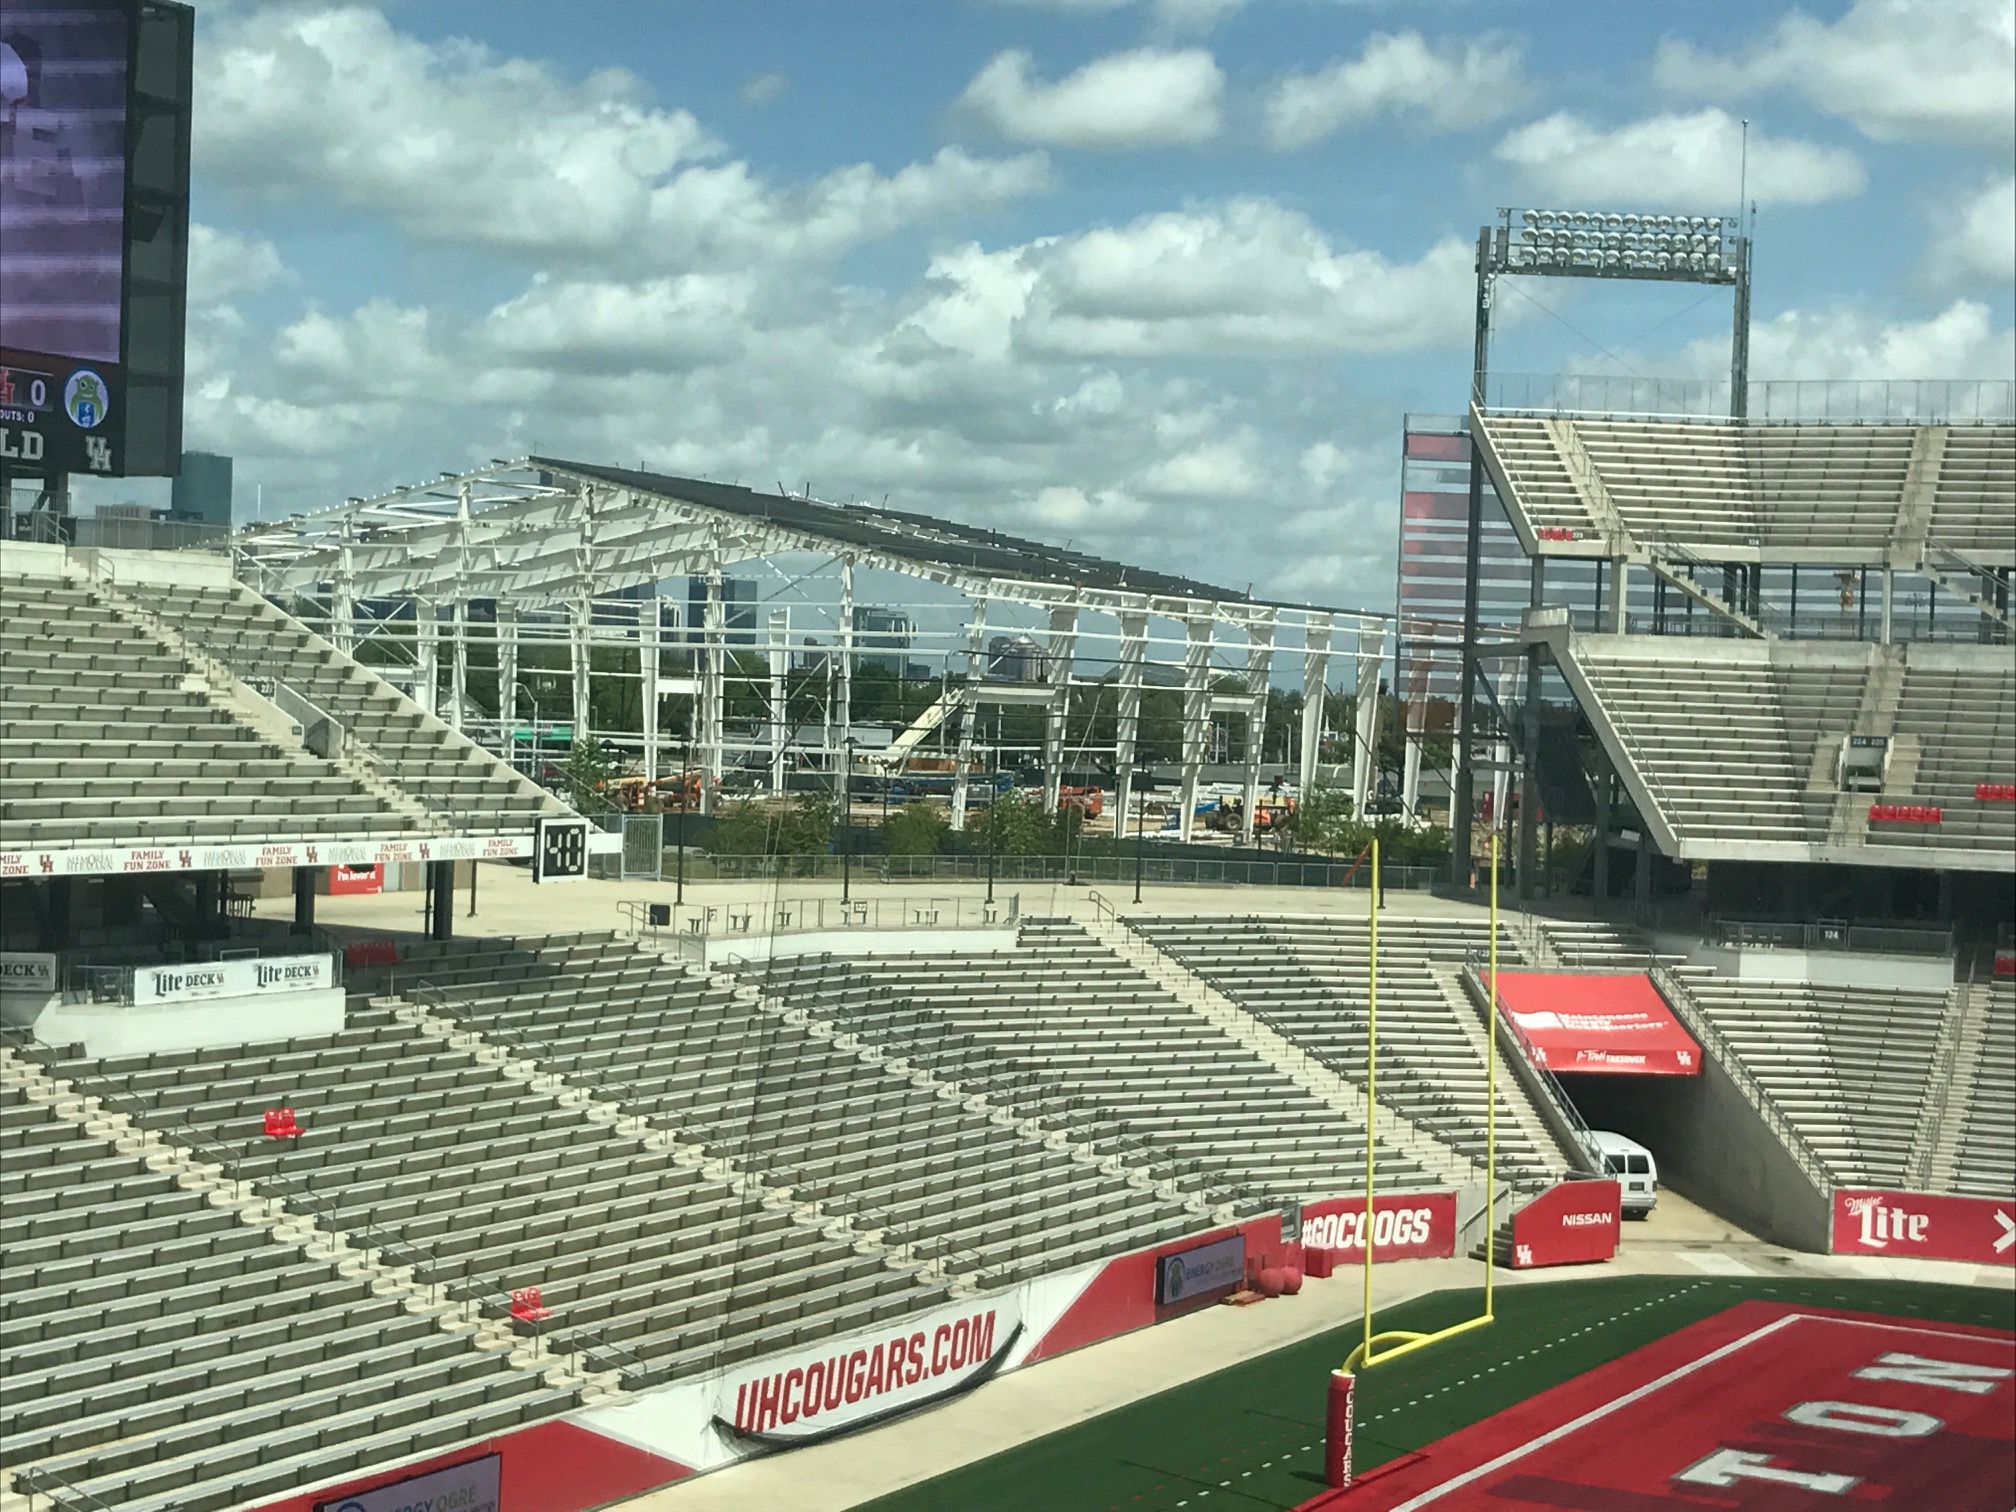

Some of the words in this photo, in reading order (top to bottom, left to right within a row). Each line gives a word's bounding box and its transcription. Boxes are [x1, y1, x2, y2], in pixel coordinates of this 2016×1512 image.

[31, 379, 46, 406] 0
[28, 410, 35, 423] 0
[85, 434, 112, 471] UH
[380, 843, 408, 852] FAMILY
[488, 839, 514, 847] FAMILY
[131, 850, 165, 860] FAMILY
[262, 846, 292, 855] FAMILY
[483, 848, 498, 857] FUN
[500, 846, 519, 856] ZONE
[546, 828, 582, 872] 40
[66, 854, 114, 864] MEMORIAL
[179, 850, 192, 868] UH
[255, 857, 273, 866] FUN
[275, 855, 298, 865] ZONE
[375, 853, 391, 862] FUN
[393, 852, 413, 861] ZONE
[2, 865, 29, 875] ZONE
[39, 855, 53, 873] UH
[124, 861, 143, 871] FUN
[146, 860, 171, 870] ZONE
[1825, 930, 1839, 939] 124
[257, 965, 283, 988] Lite
[284, 966, 312, 978] DECK
[155, 972, 183, 997] Lite
[185, 973, 215, 987] DECK
[1562, 1212, 1612, 1227] NISSAN
[1857, 1203, 1931, 1248] Lite
[1302, 1208, 1432, 1250] #GOCOOGS
[734, 1310, 996, 1438] UHCOUGARS.COM
